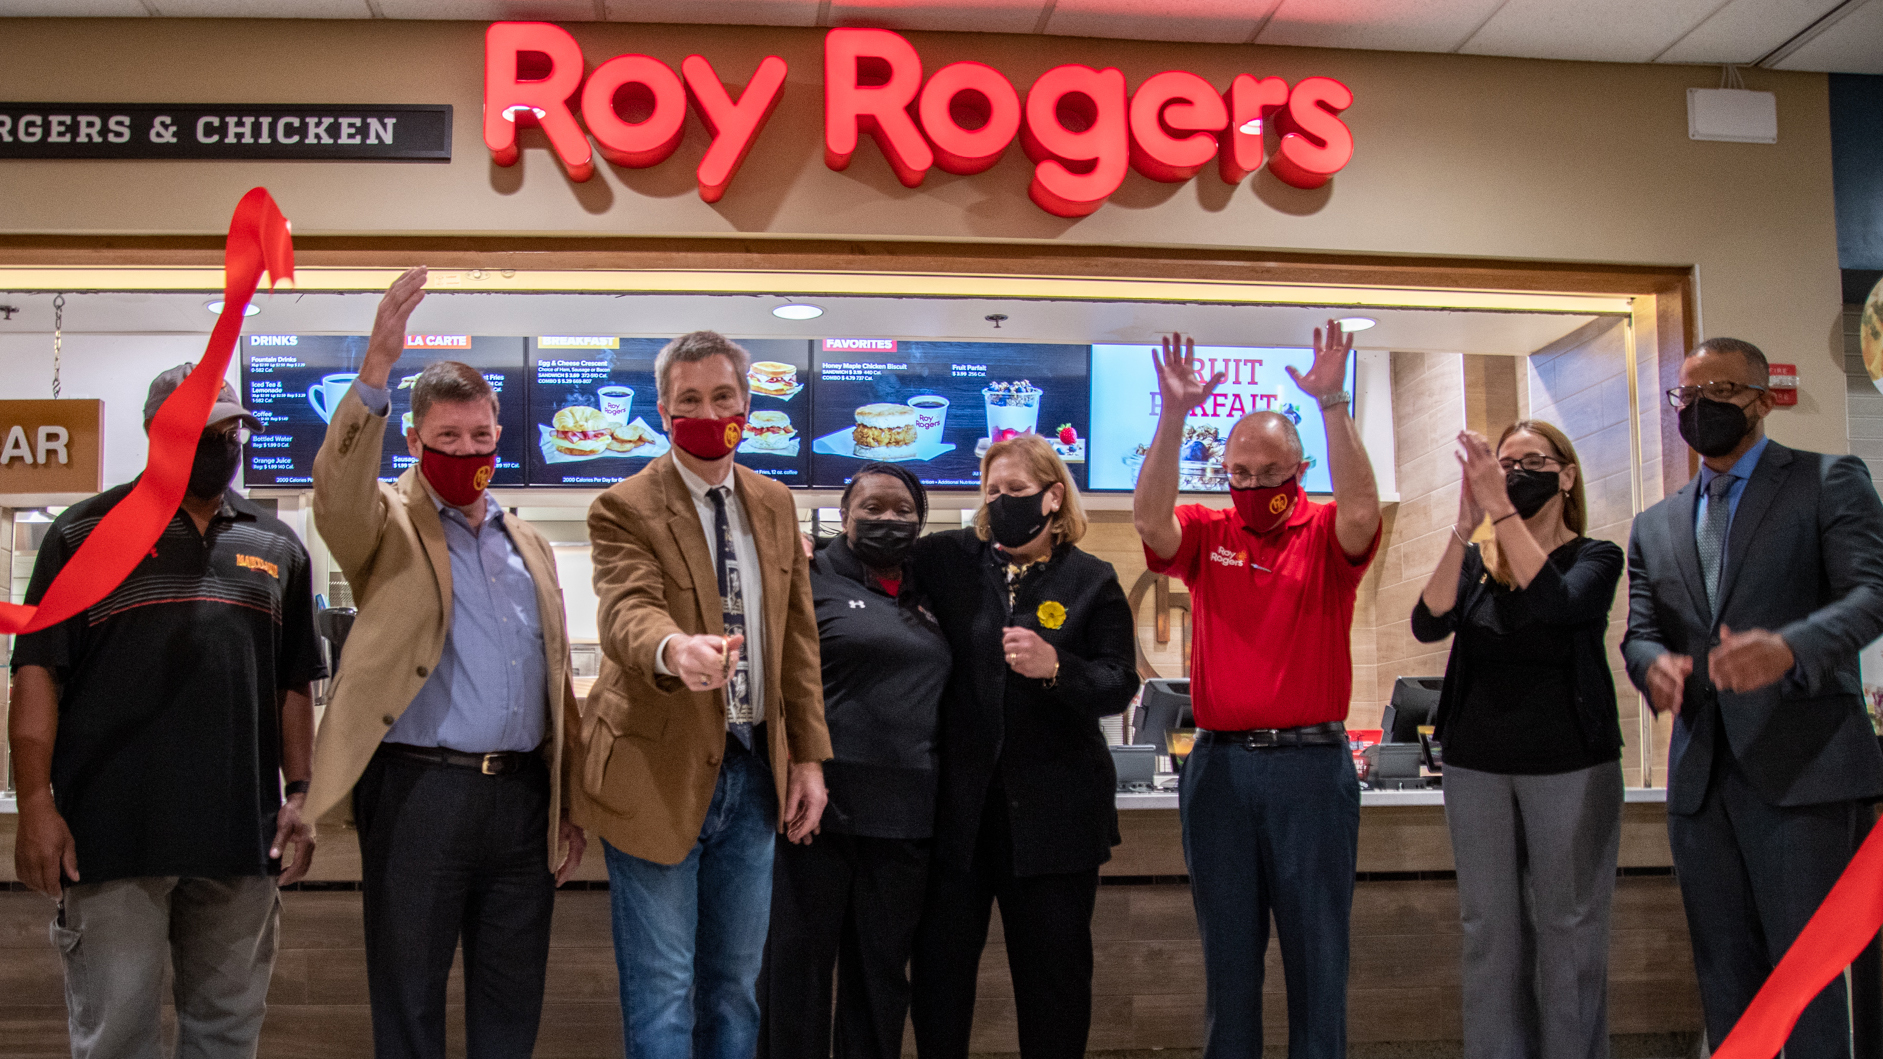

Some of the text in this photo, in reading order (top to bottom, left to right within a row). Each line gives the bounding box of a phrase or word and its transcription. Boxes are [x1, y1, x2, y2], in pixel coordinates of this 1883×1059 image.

[484, 21, 1354, 217] Roy Rogers
[150, 116, 177, 144] &
[196, 116, 398, 145] CHICKEN
[251, 336, 298, 346] DRINKS
[407, 336, 466, 346] LA CARTE
[542, 336, 615, 346] BREAKFAST
[826, 339, 893, 349] FAVORITES
[1182, 358, 1263, 385] RUIT
[1149, 392, 1278, 417] PRFAIT
[605, 407, 626, 416] Rogers
[920, 414, 934, 422] Roy
[916, 420, 940, 430] Rogers
[0, 425, 69, 464] AR
[1218, 546, 1236, 559] Roy
[1210, 552, 1243, 567] Rogers
